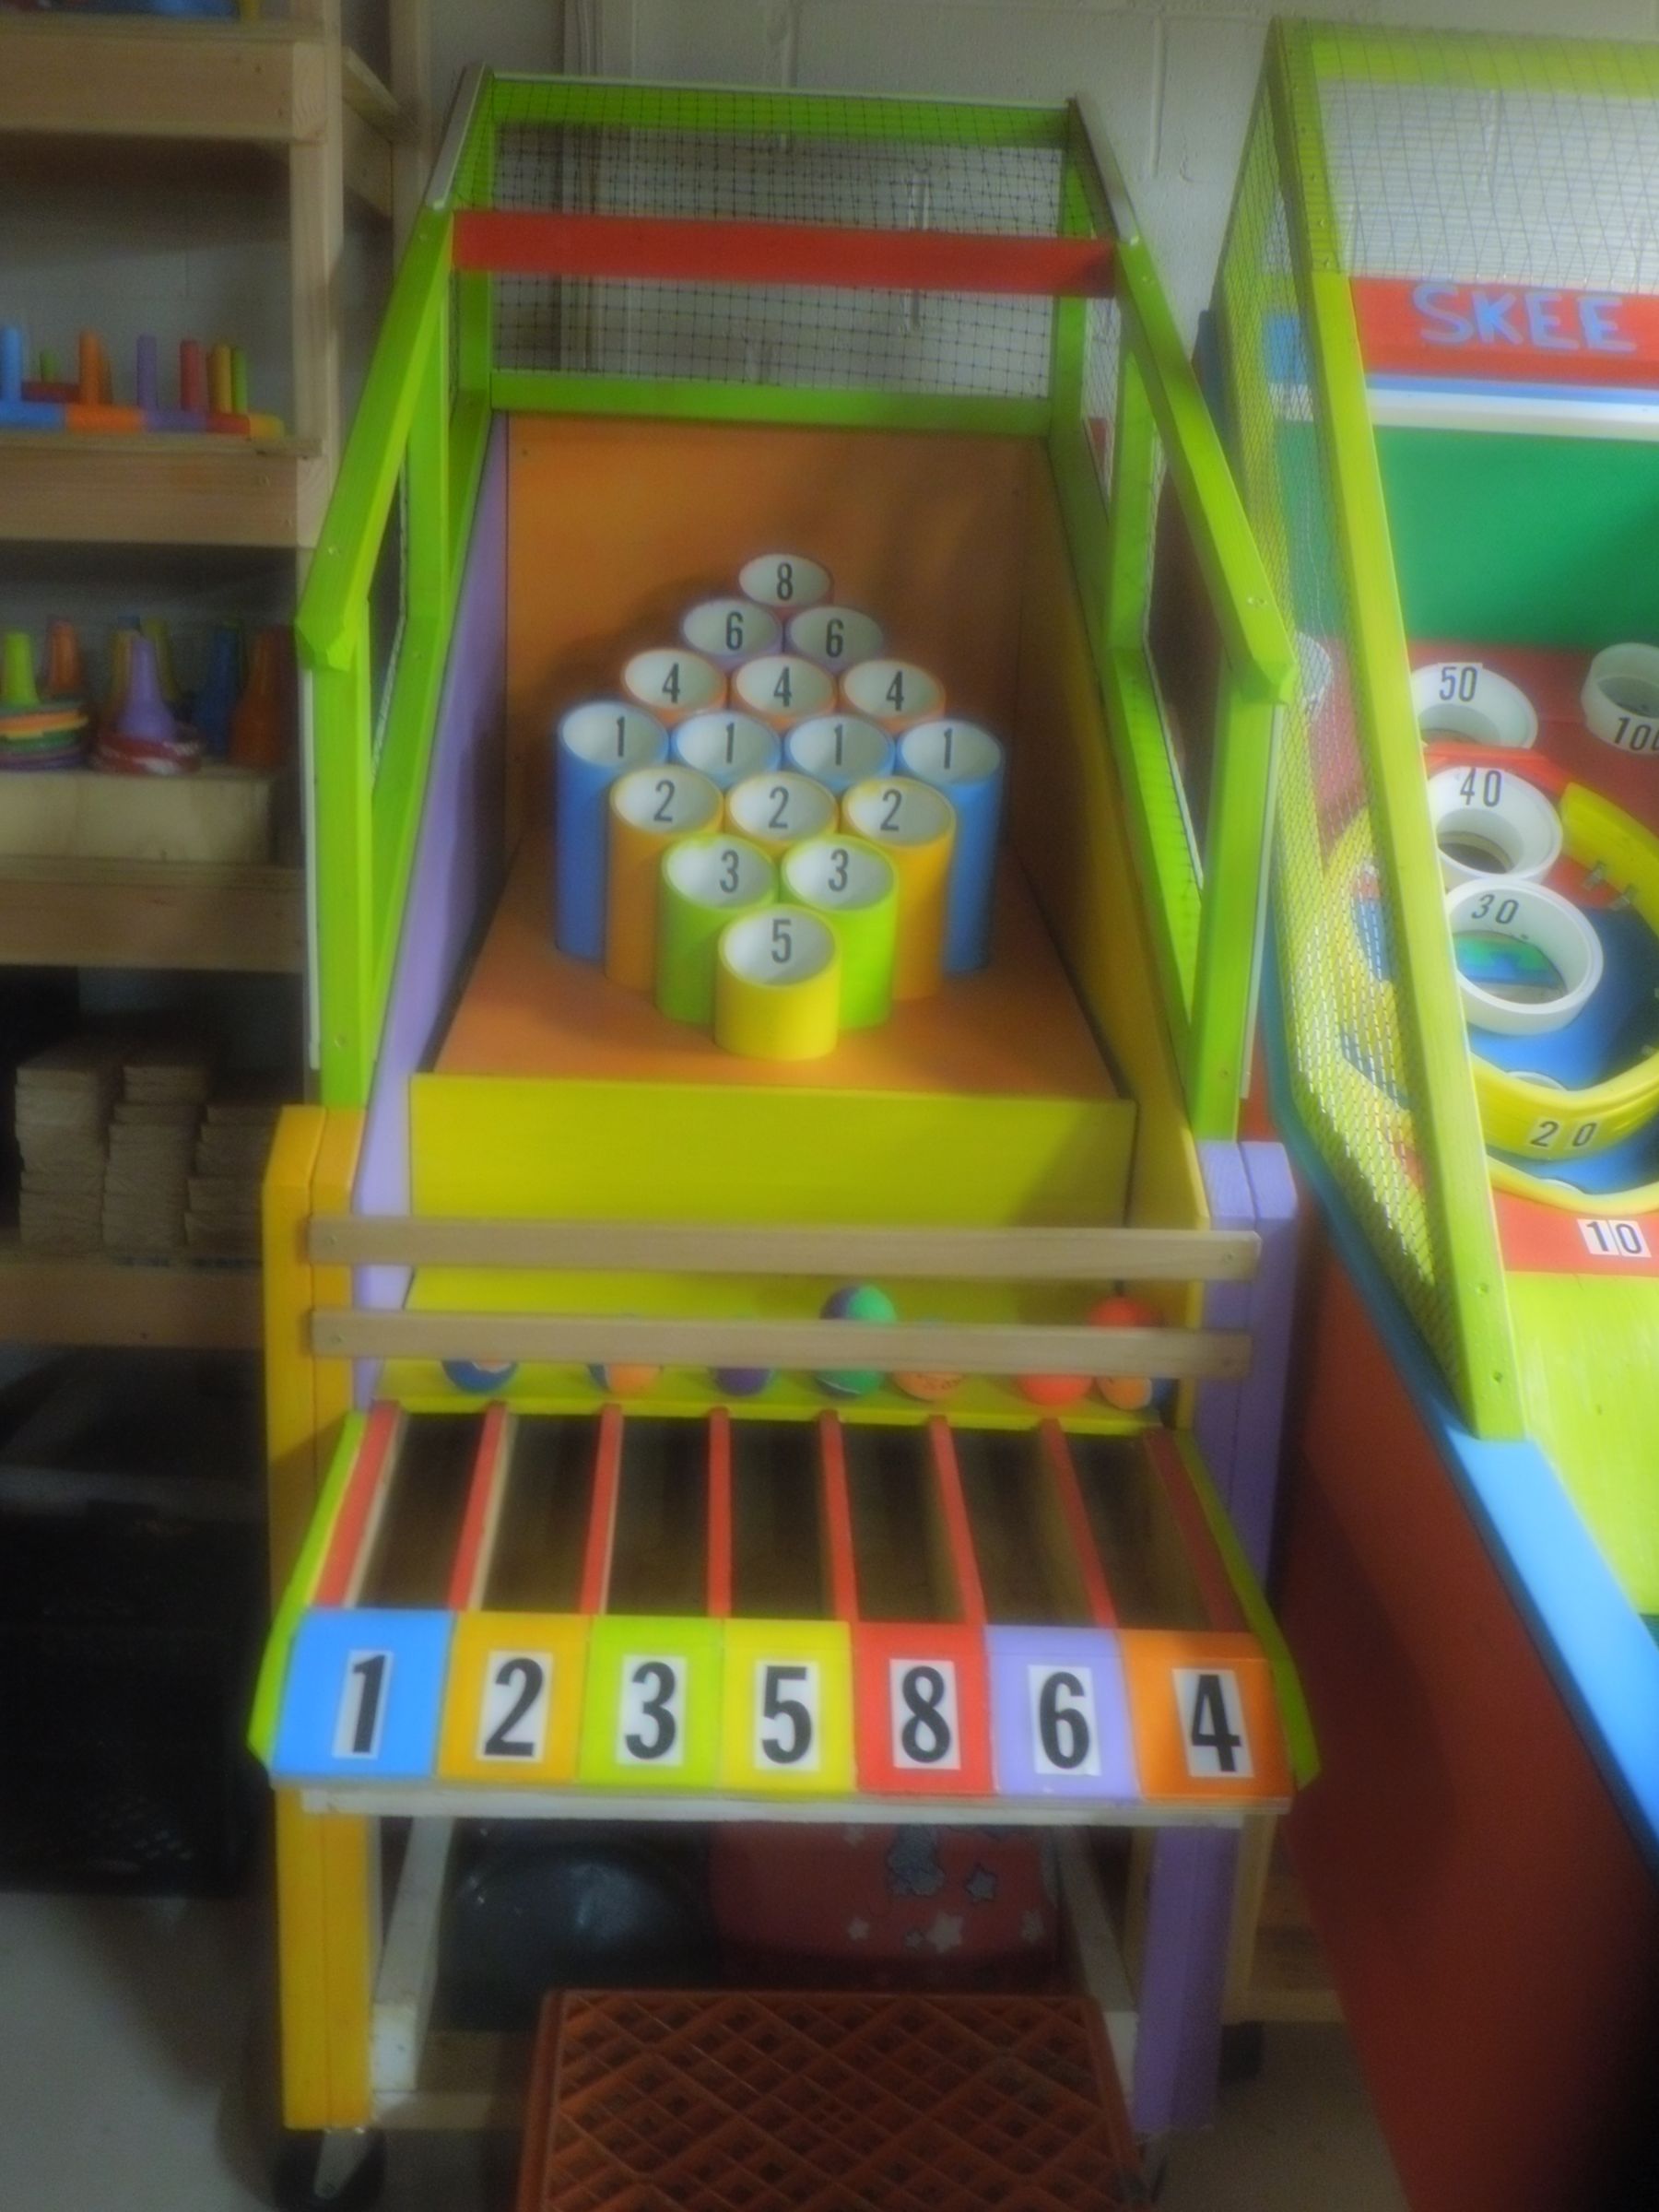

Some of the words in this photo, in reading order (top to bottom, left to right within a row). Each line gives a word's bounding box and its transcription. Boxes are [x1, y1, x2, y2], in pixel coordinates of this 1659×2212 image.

[1412, 281, 1637, 354] SKEE
[776, 563, 794, 601] 8
[725, 611, 744, 651] 6
[825, 618, 844, 658] 6
[662, 663, 680, 704] 4
[773, 666, 792, 707] 4
[886, 670, 905, 711] 4
[1439, 665, 1477, 702] 50
[616, 715, 626, 759] 1
[724, 722, 735, 764] 1
[833, 724, 843, 767] 1
[942, 727, 953, 771] 1
[653, 780, 675, 823] 2
[768, 786, 789, 829] 2
[880, 789, 902, 831] 2
[1460, 770, 1501, 807] 40
[719, 850, 739, 893] 3
[828, 849, 849, 892] 3
[1471, 893, 1519, 924] 30
[771, 919, 792, 963] 5
[1586, 1220, 1642, 1254] 10
[352, 1655, 386, 1752] 1
[487, 1658, 545, 1757] 2
[626, 1662, 677, 1759] 3
[761, 1666, 812, 1763] 5
[901, 1665, 951, 1763] 8
[1039, 1671, 1089, 1769] 6
[1191, 1675, 1241, 1772] 4
